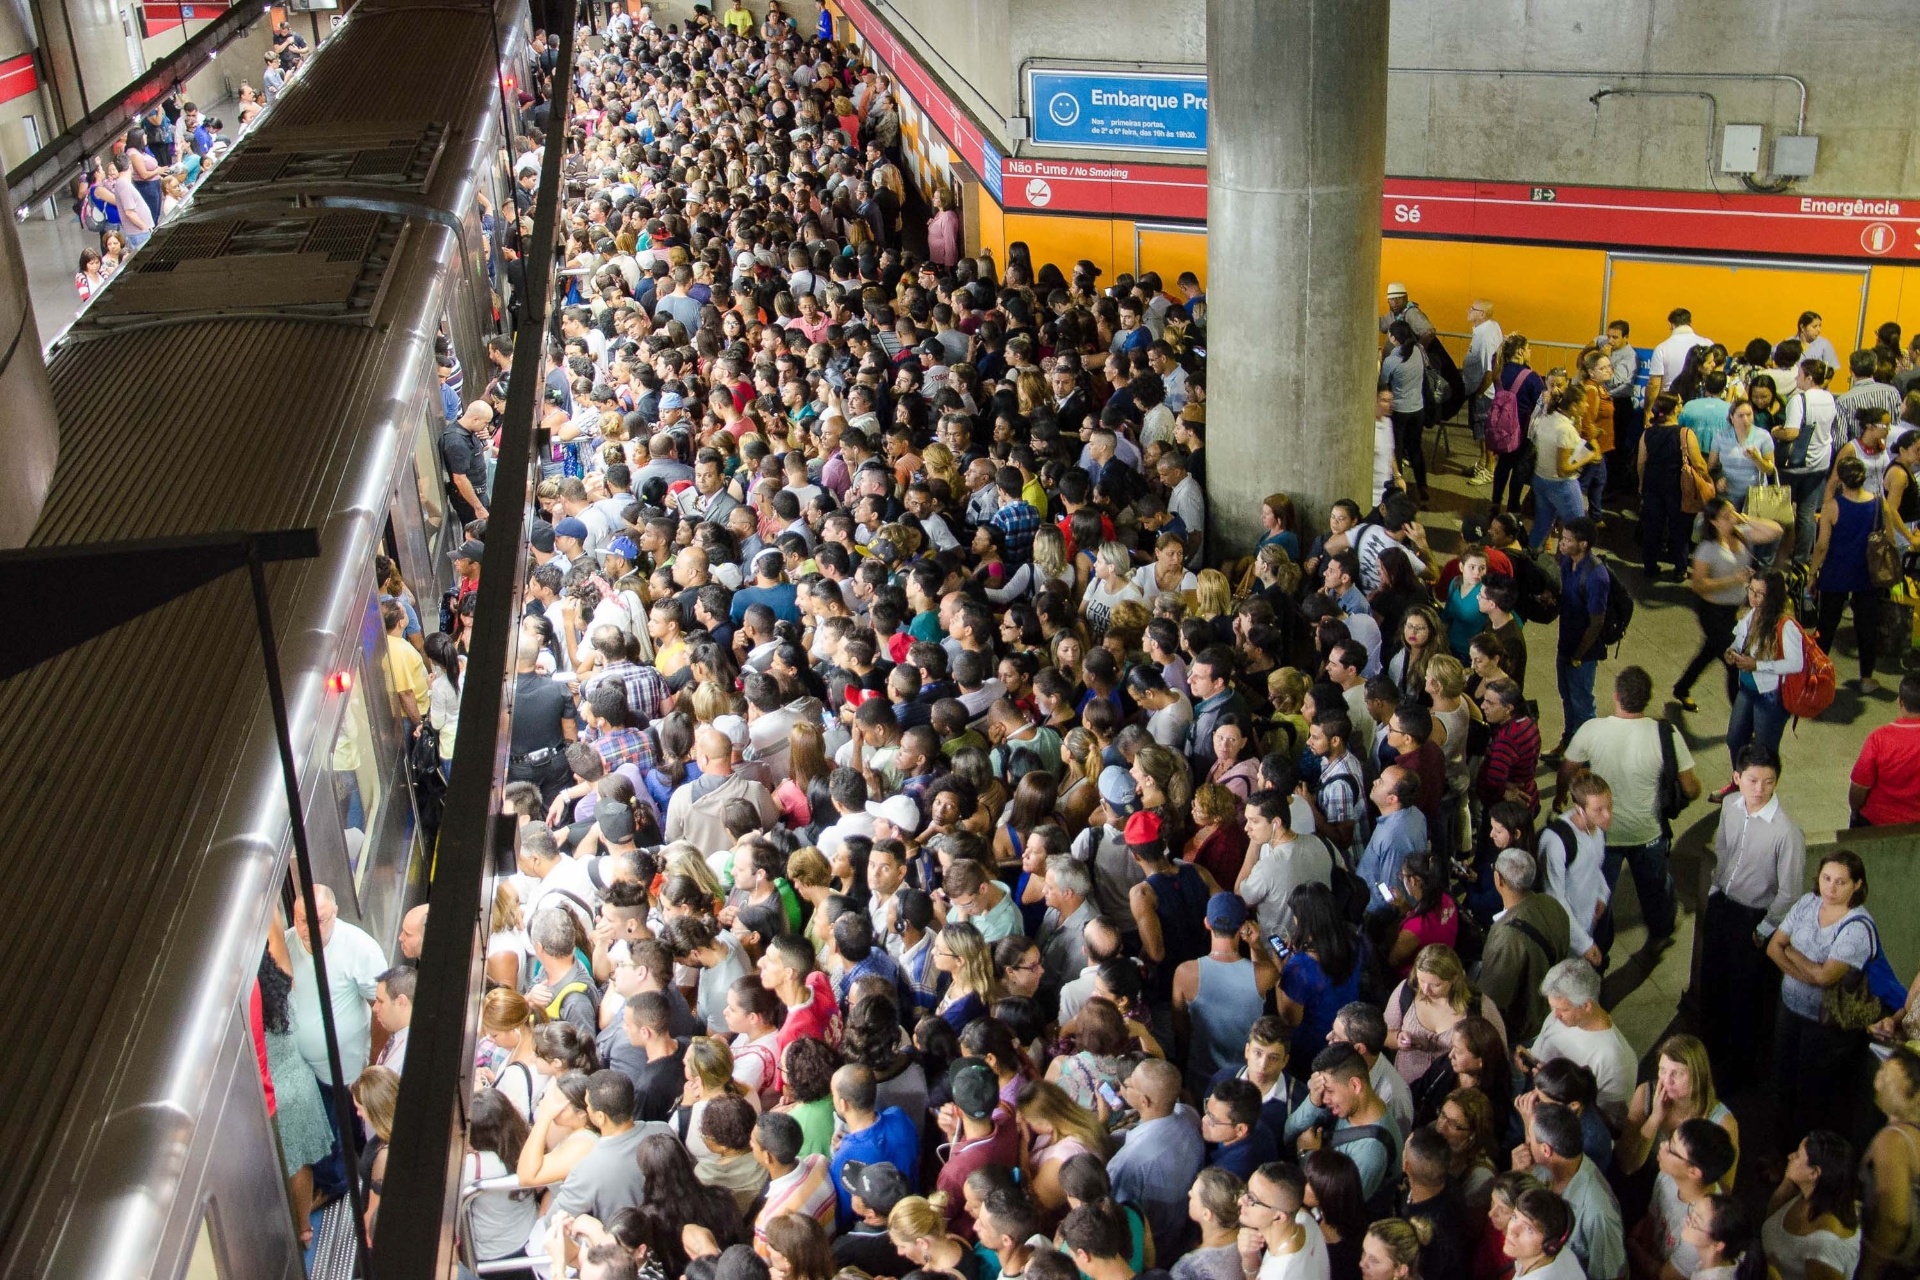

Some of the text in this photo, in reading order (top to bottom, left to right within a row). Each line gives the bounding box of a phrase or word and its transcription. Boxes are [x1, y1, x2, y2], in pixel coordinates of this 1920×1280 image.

[1091, 89, 1178, 111] Embarque
[1091, 118, 1165, 129] Nas primeiras portas,
[1122, 128, 1139, 136] feira,
[1139, 129, 1152, 137] das
[1009, 161, 1032, 173] Não
[1035, 162, 1068, 175] Fume
[1075, 167, 1087, 176] No
[1089, 168, 1128, 179] Smoking
[1394, 204, 1421, 223] Sé
[1800, 198, 1899, 217] Emergência
